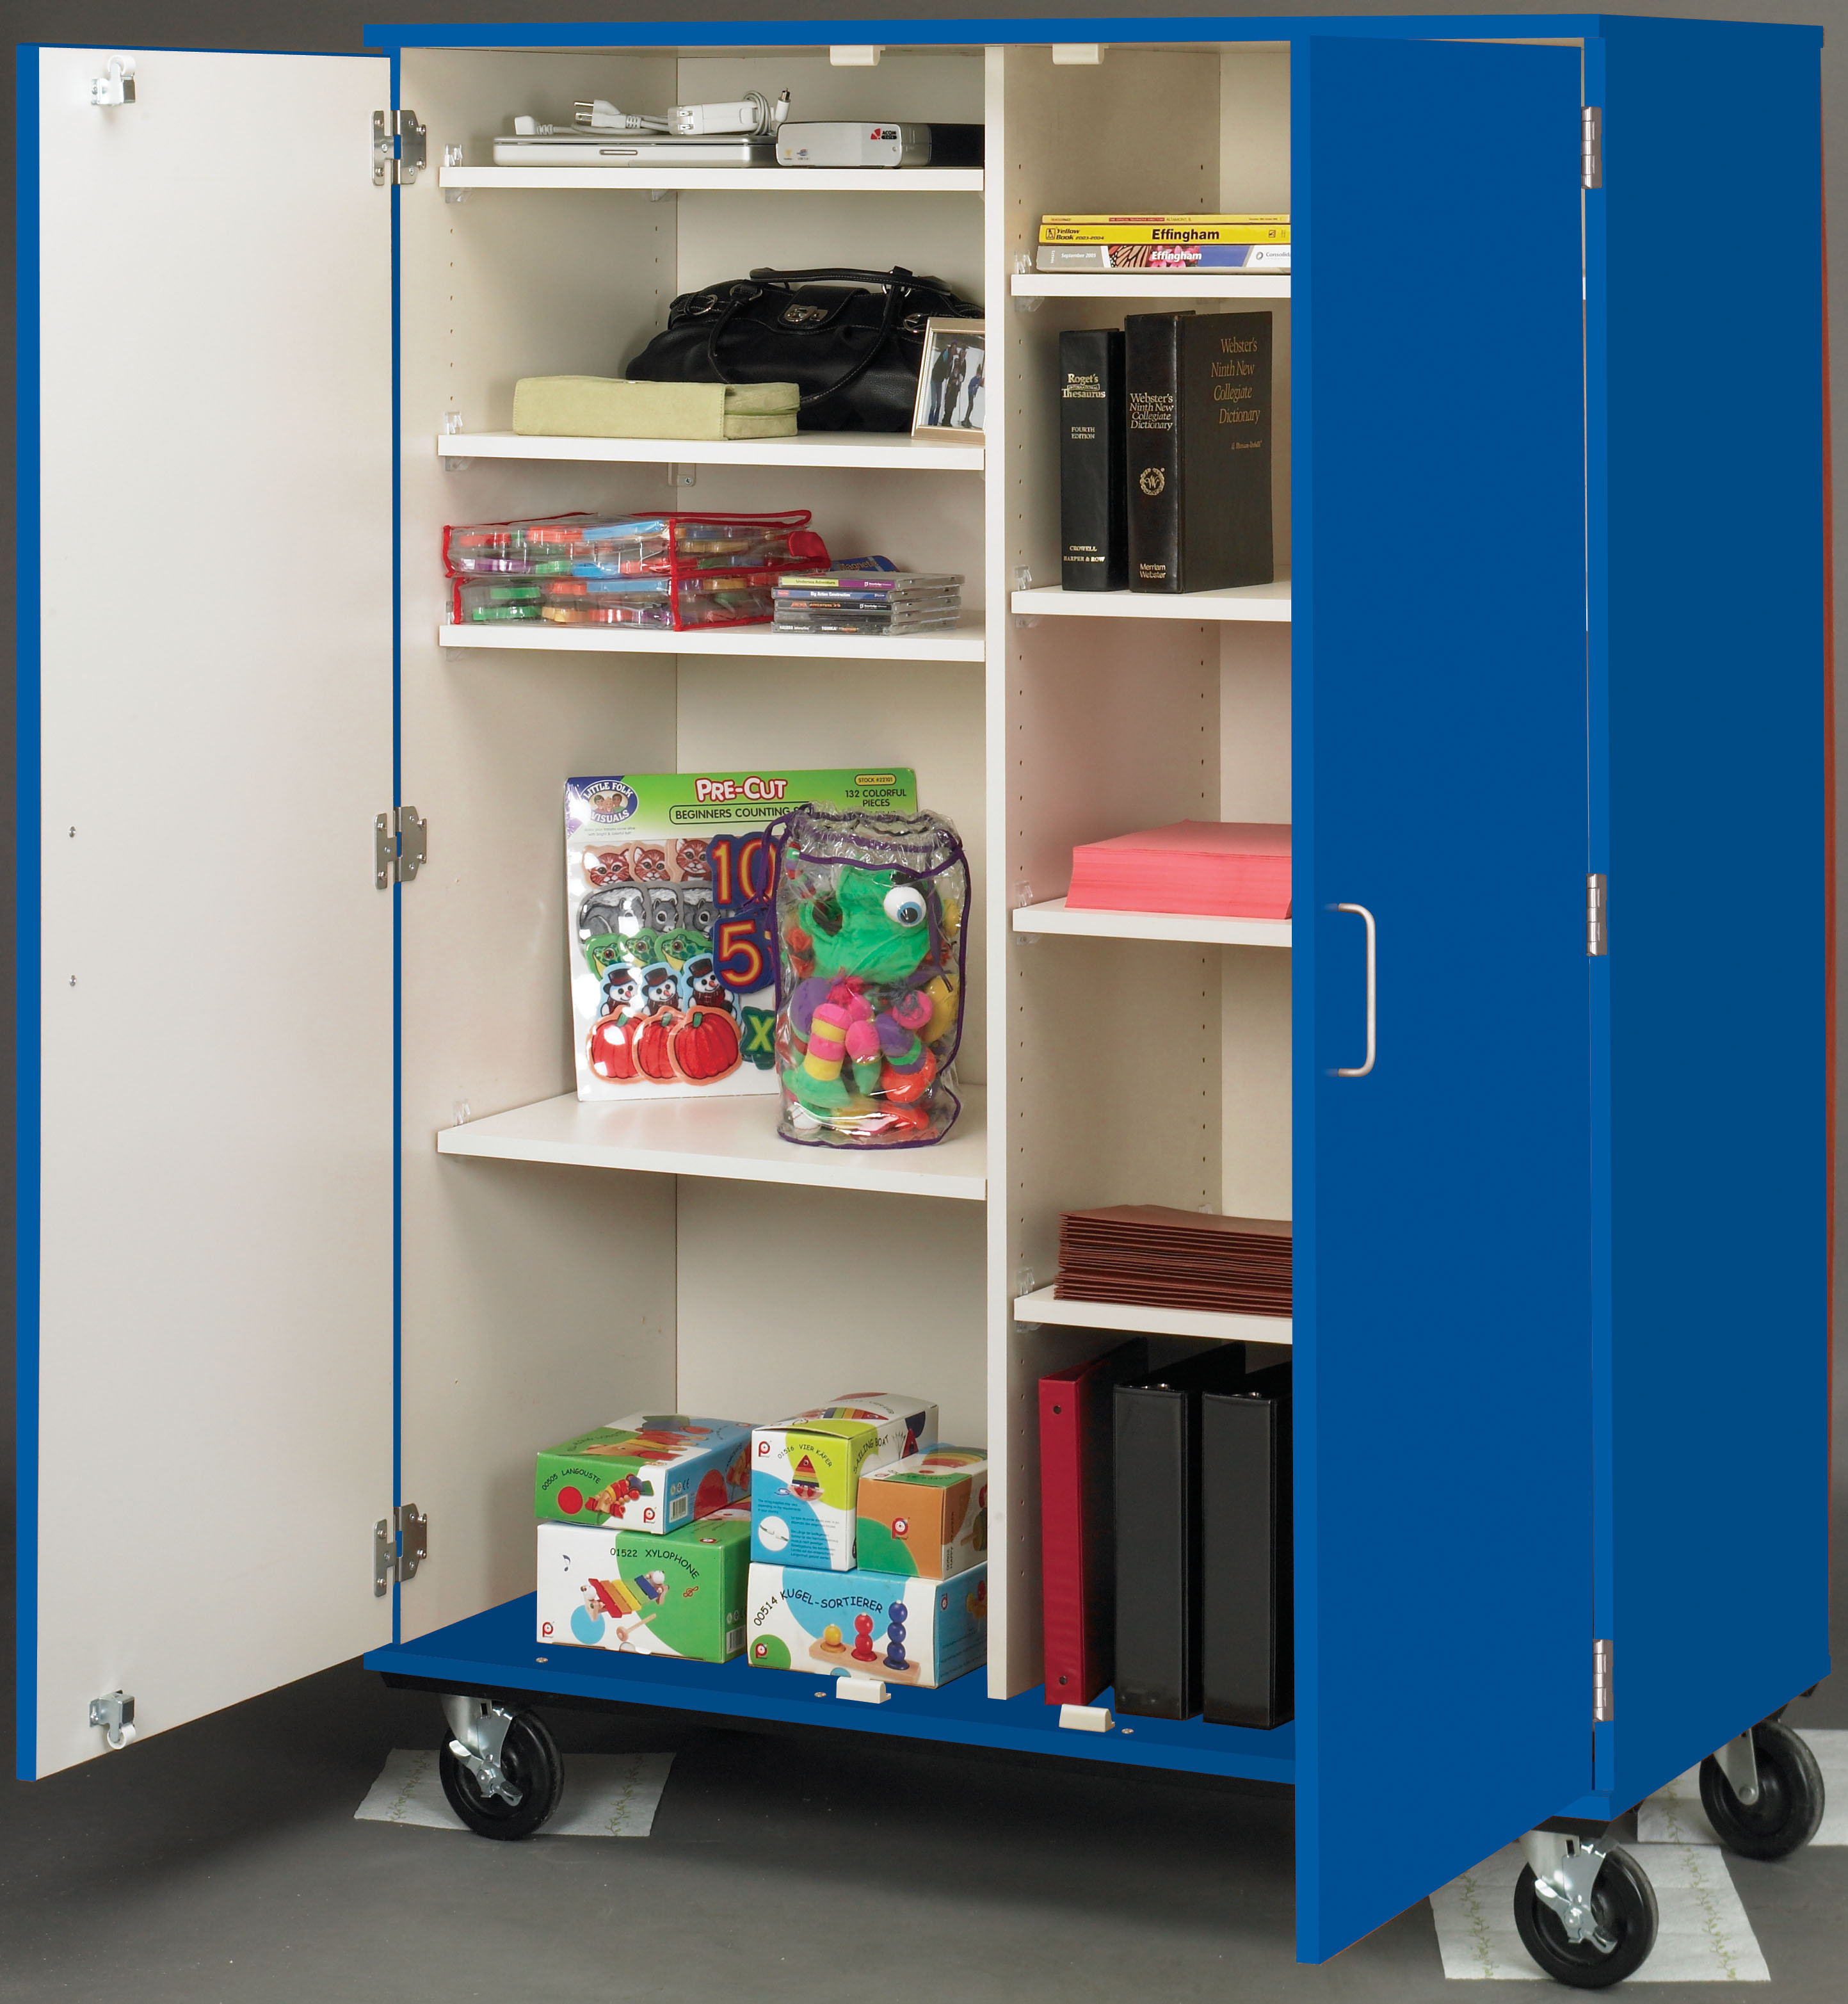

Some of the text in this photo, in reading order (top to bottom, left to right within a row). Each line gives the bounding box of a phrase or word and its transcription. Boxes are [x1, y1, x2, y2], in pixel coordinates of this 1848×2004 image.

[1152, 229, 1220, 242] Effingham
[1152, 250, 1202, 262] Effingham
[1221, 336, 1258, 353] Webster's
[1211, 360, 1255, 377] Ninth New
[1067, 373, 1099, 385] Roget's
[1061, 388, 1106, 398] Thesaurus
[1130, 392, 1173, 403] Webster's
[1214, 383, 1253, 403] Collegiate
[1129, 402, 1174, 412] Ninth New
[1132, 410, 1171, 422] Collegiate
[1219, 407, 1260, 425] Dictionary
[1130, 420, 1173, 431] Dictionary
[583, 782, 634, 799] LITTLE FOLK
[696, 777, 787, 802] PRE-CUT
[845, 789, 906, 798] 132 COLORFUL
[862, 798, 890, 807] PIECES
[591, 809, 630, 823] VISUALS
[675, 808, 732, 820] BEGINNERS
[735, 807, 790, 818] COUNTING
[712, 839, 775, 904] 10
[718, 920, 762, 987] 5
[777, 1446, 794, 1460] 01516
[799, 1444, 814, 1452] VIER
[853, 1434, 889, 1474] SAILING BOAT
[542, 1467, 601, 1491] 00505 LANGOUSTE
[610, 1547, 700, 1580] 01522 XYLOPHONE
[753, 1588, 883, 1626] 00514 KUGEL-SORTIERER
